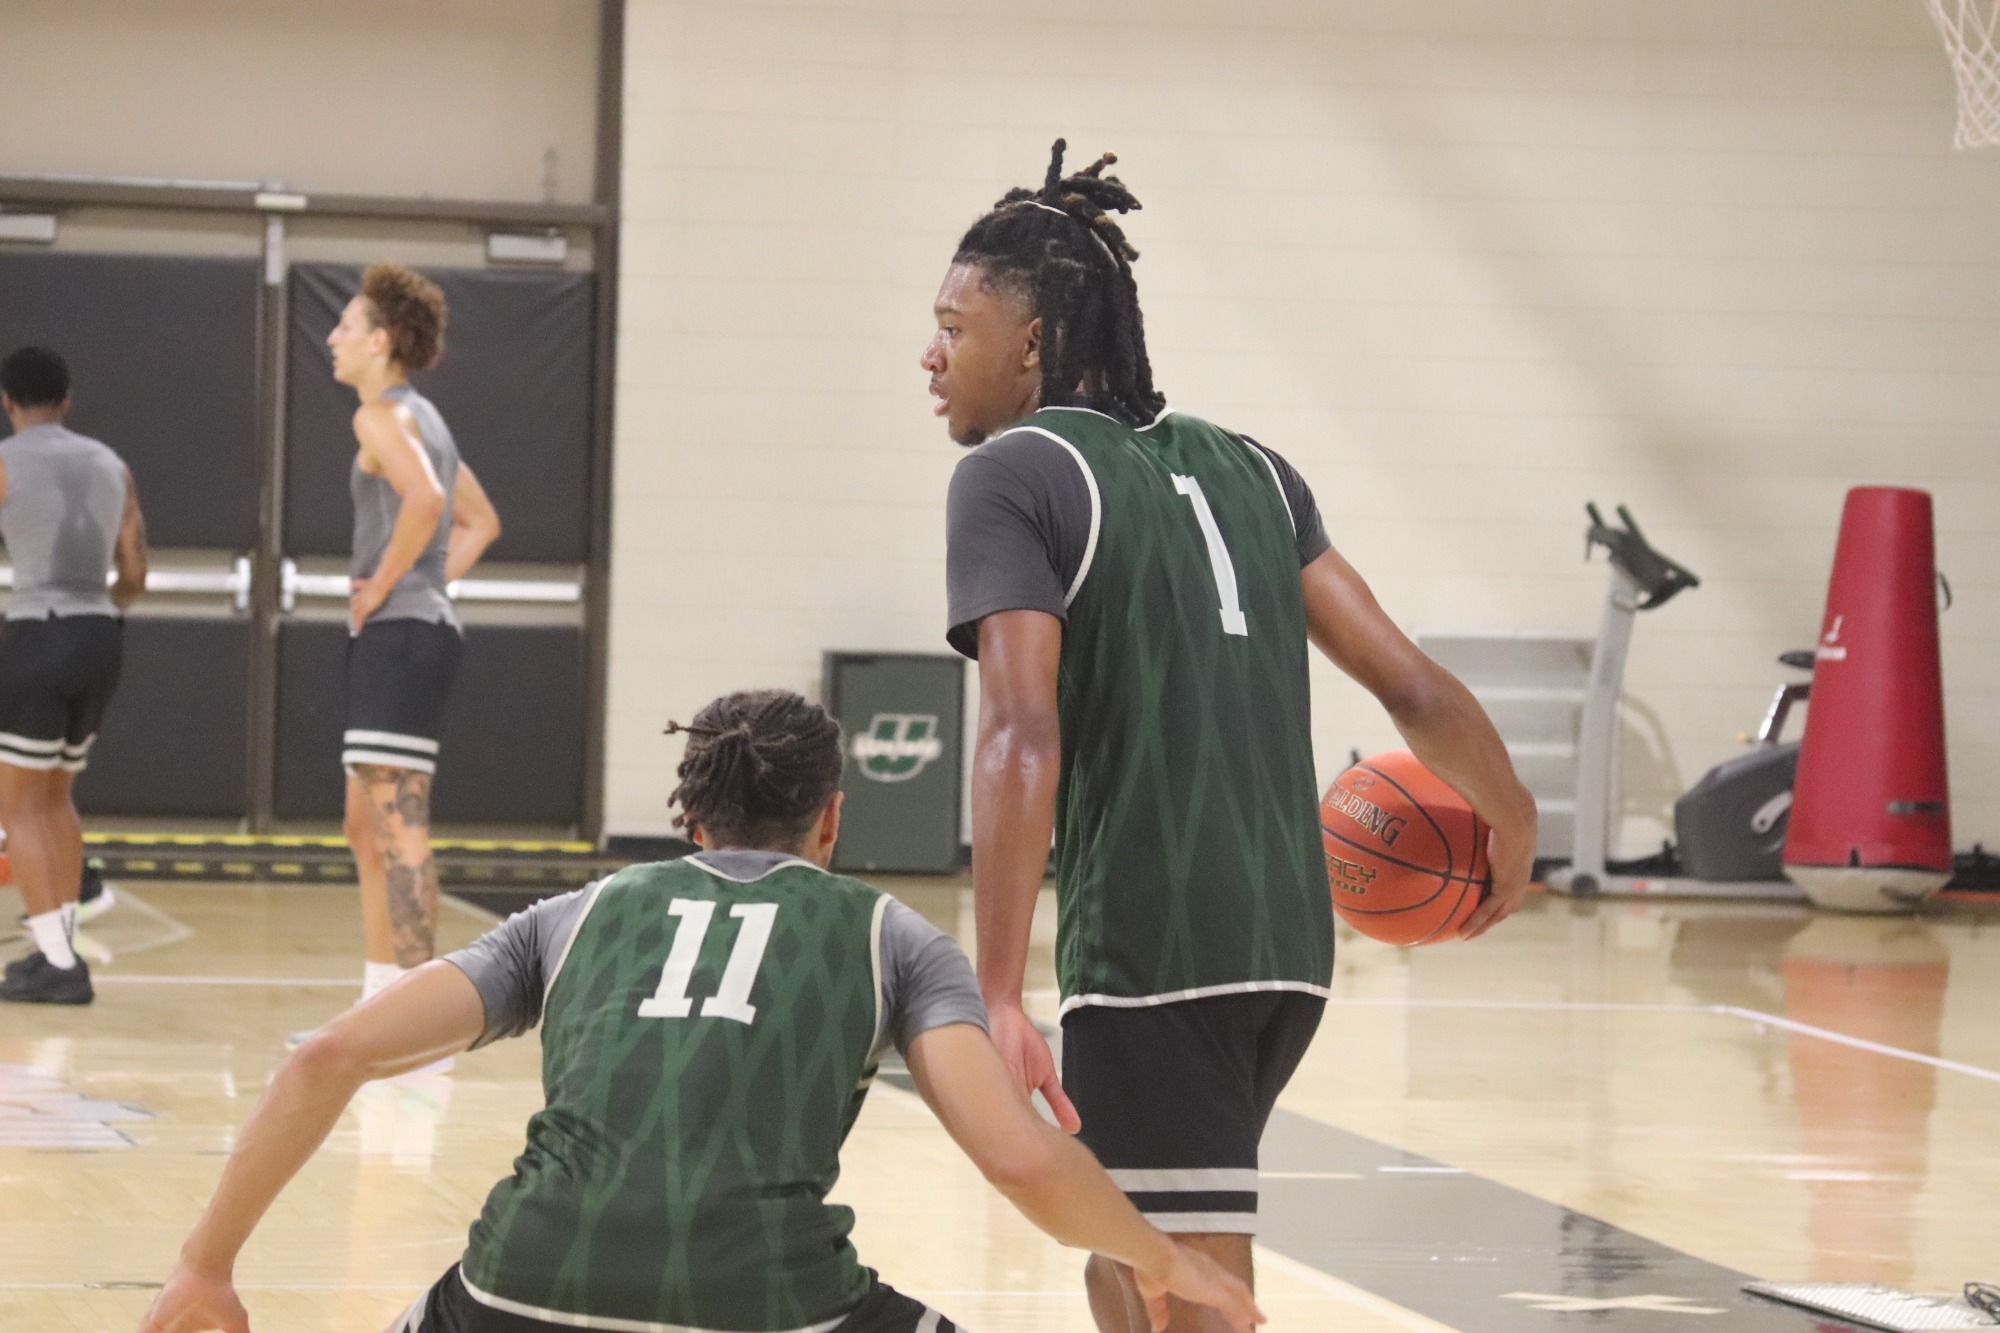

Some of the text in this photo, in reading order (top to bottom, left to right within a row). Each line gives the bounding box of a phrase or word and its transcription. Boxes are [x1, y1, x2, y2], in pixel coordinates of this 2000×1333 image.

[1170, 473, 1248, 636] 1
[1328, 855, 1376, 884] ACY
[637, 898, 779, 1025] 11
